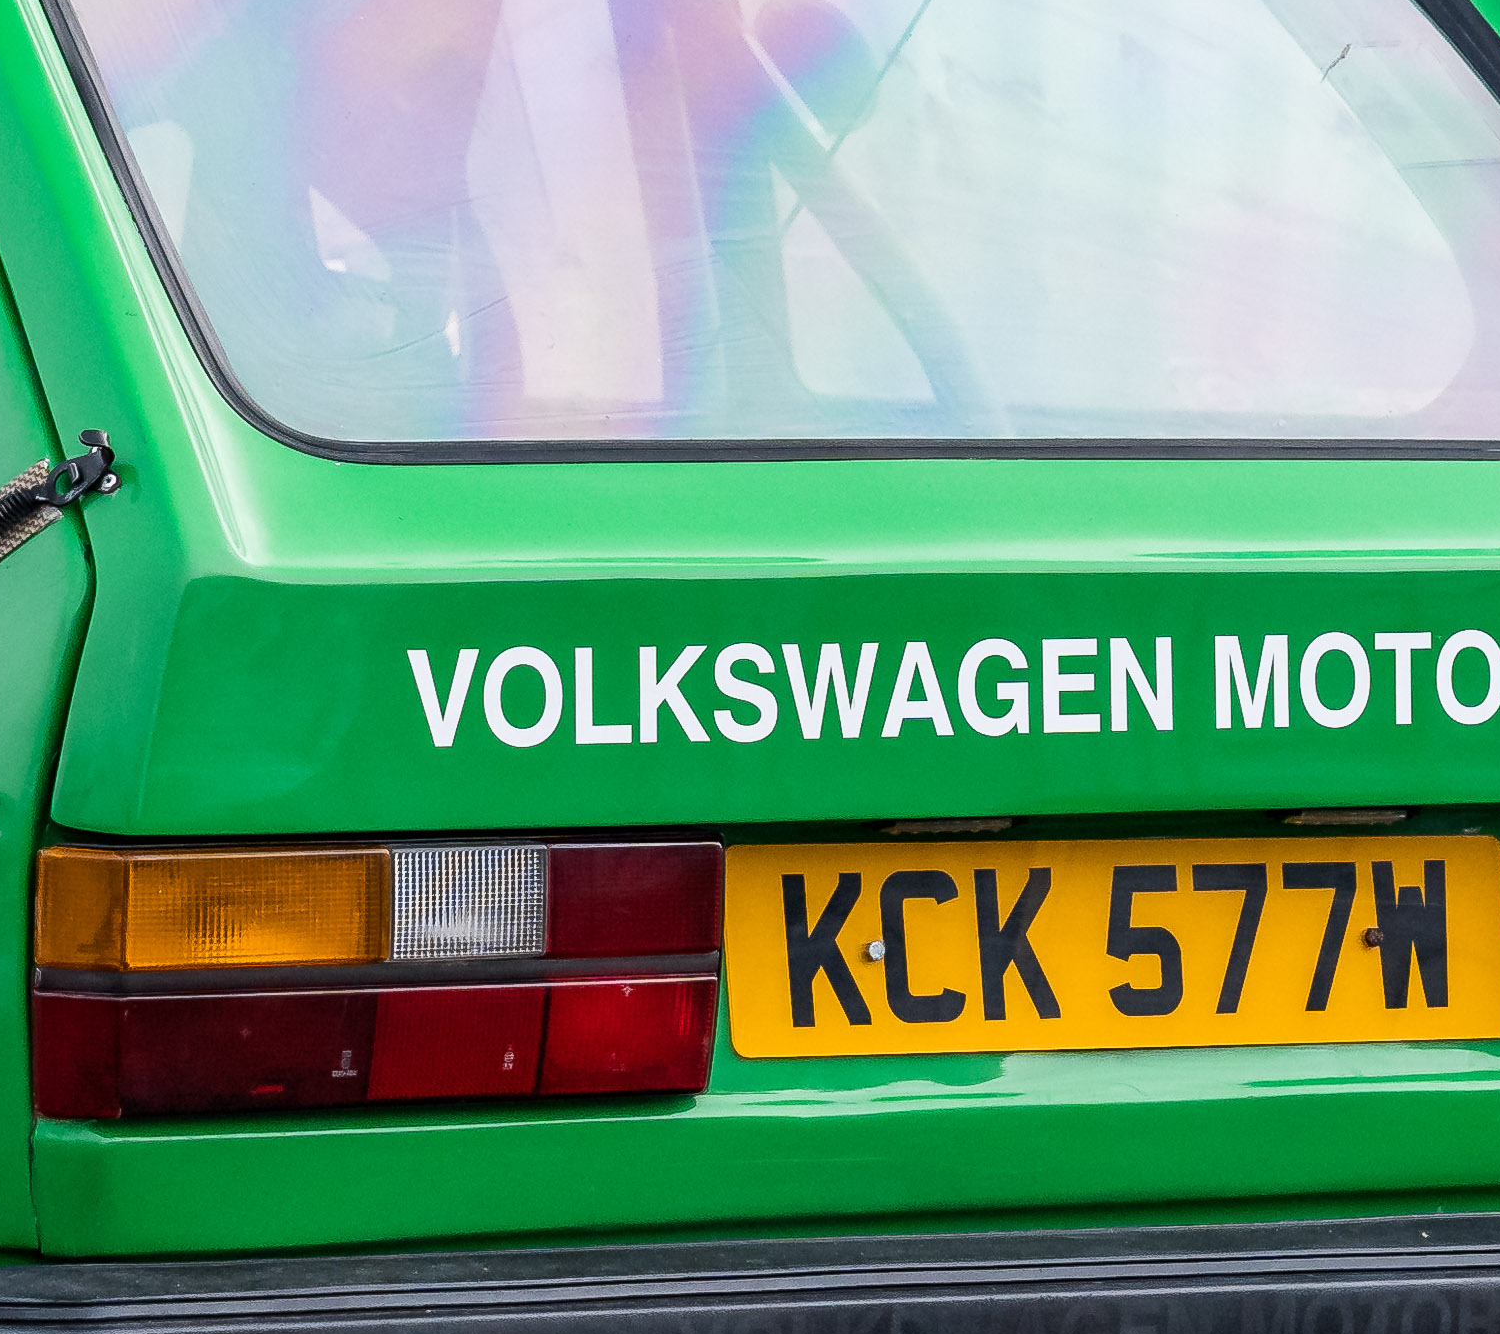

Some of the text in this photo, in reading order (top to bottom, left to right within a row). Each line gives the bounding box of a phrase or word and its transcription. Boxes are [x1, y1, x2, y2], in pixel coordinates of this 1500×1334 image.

[406, 636, 1175, 748] VOLKSWAGEN
[780, 859, 1449, 1029] KCK 577W
